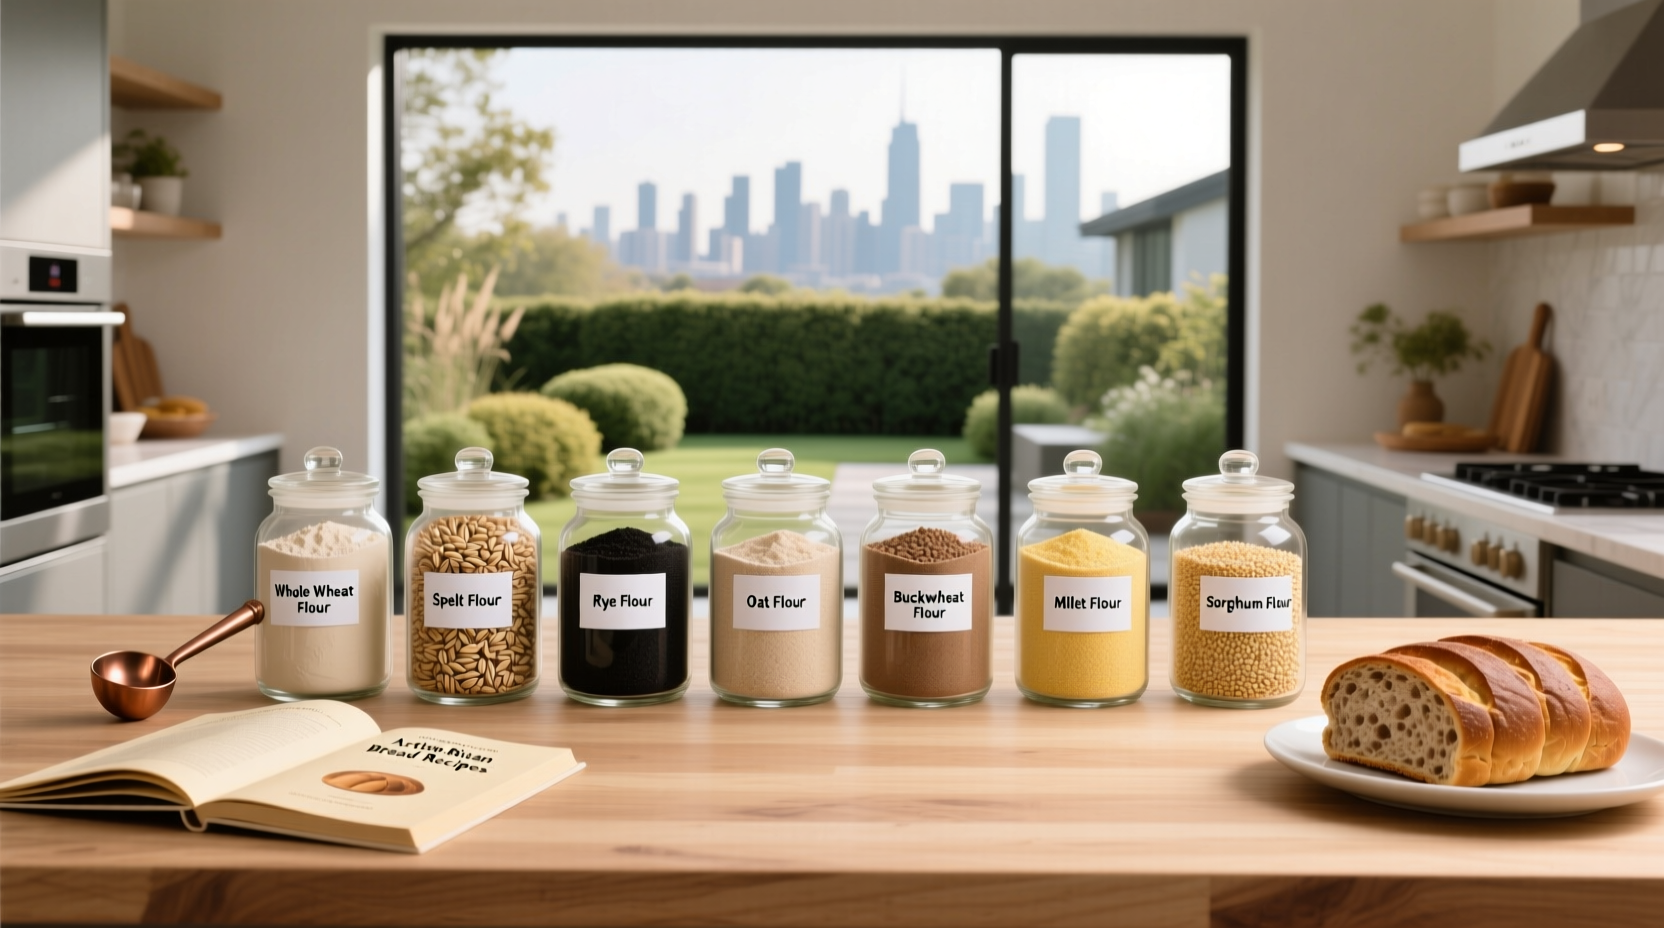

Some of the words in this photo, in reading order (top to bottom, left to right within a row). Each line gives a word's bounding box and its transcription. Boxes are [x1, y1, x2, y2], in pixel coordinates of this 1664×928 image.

[274, 583, 310, 598] Whole
[313, 583, 354, 598] Wheat
[893, 590, 965, 604] Buckwheat
[297, 601, 331, 614] Flour
[432, 593, 463, 609] Spelt
[467, 594, 502, 607] Flour
[593, 594, 617, 611] Rye
[620, 594, 653, 608] Flour
[746, 594, 769, 609] Oat
[773, 595, 806, 609] Flour
[1090, 597, 1122, 610] Flour
[1206, 595, 1262, 613] Sorghum
[913, 607, 946, 618] Flour
